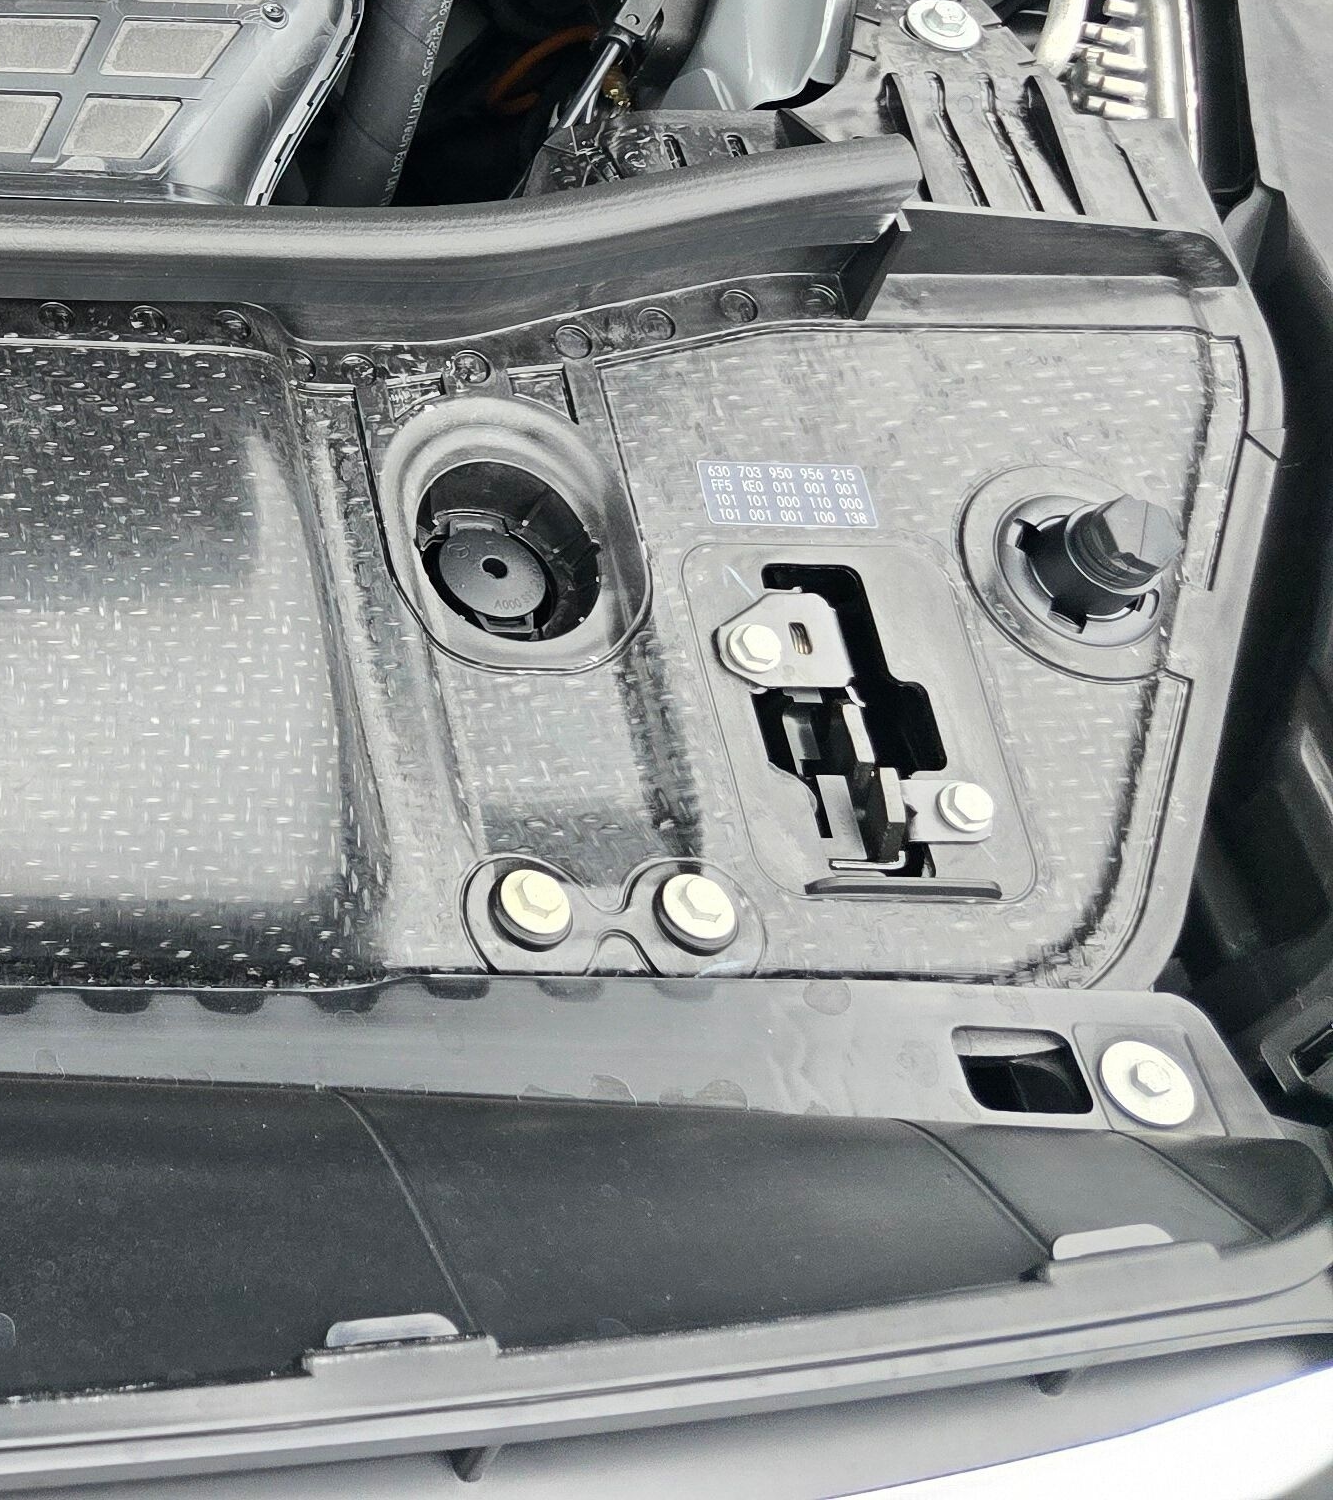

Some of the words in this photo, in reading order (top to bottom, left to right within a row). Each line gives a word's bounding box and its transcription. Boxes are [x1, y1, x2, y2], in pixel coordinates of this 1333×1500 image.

[708, 466, 730, 476] 630
[737, 466, 762, 478] 703
[769, 467, 792, 479] 950
[800, 468, 824, 480] 956
[831, 469, 854, 480] 215
[711, 479, 732, 491] FF5
[773, 482, 795, 493] 011
[804, 483, 826, 494] 001
[835, 483, 858, 495] 001
[715, 494, 736, 506] 101
[747, 495, 768, 506] 101
[777, 496, 800, 508] 000
[810, 497, 831, 508] 110
[839, 498, 862, 509] 000
[719, 509, 741, 520] 101
[749, 509, 772, 521] 001
[780, 510, 803, 522] 001
[813, 511, 835, 523] 100
[845, 512, 867, 524] 138
